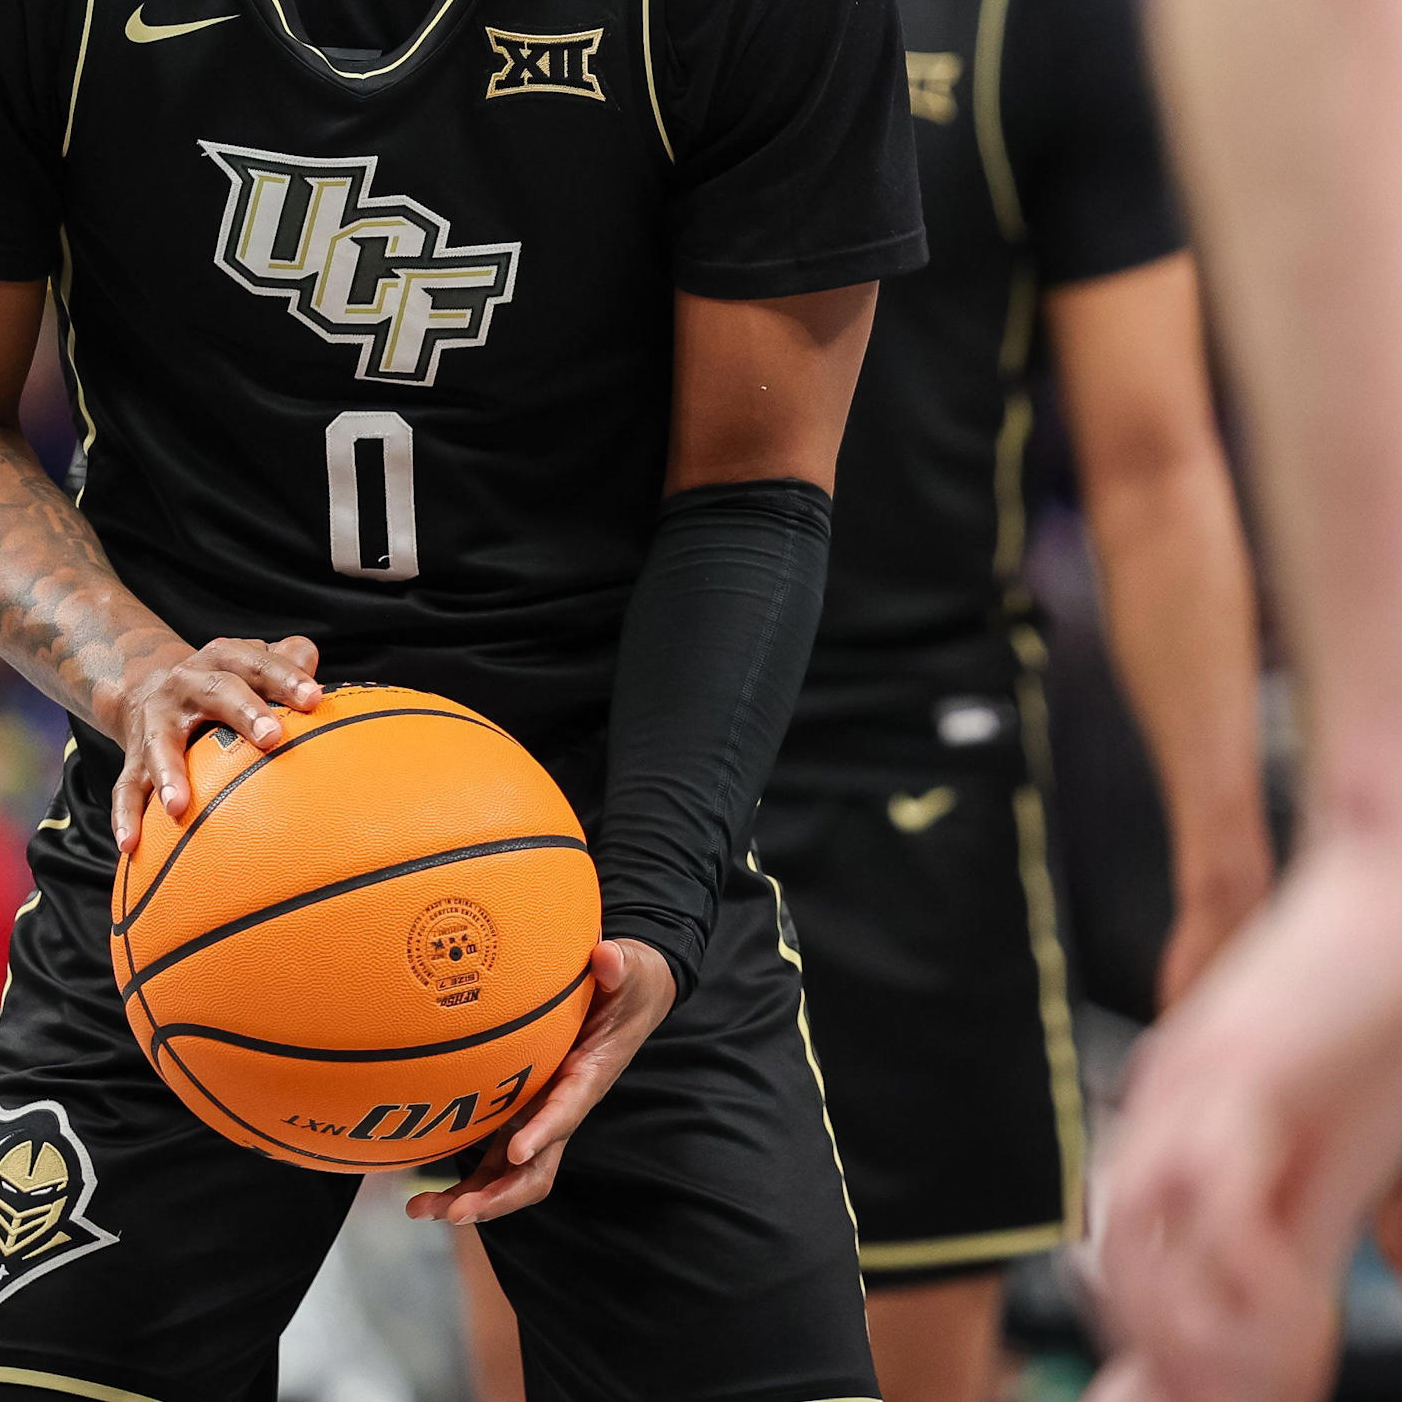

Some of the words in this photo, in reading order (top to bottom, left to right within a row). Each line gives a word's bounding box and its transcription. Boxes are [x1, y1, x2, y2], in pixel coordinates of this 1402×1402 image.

[487, 28, 604, 100] XII
[208, 148, 513, 382] UCF
[325, 411, 420, 581] 0
[451, 974, 475, 985] SIZE
[280, 1115, 347, 1136] NXT
[348, 1064, 533, 1141] EVO
